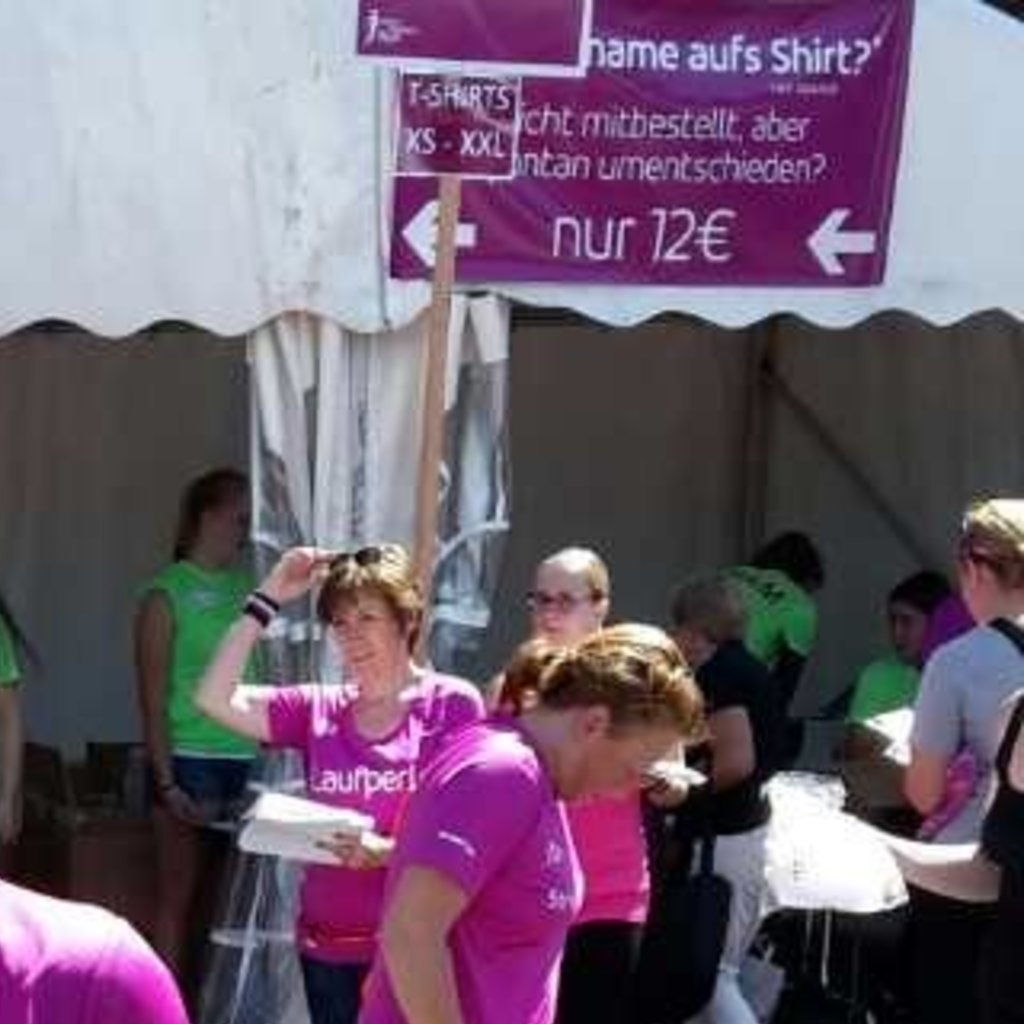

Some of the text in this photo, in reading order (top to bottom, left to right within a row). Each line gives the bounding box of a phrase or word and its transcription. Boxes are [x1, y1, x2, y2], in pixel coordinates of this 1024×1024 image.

[687, 35, 762, 73] aufs
[409, 81, 512, 110] T-SHIRTS
[520, 101, 809, 143] icht mitbestellt, aber
[404, 127, 437, 155] XS
[460, 129, 506, 158] XXL
[597, 147, 827, 183] umentschieden?
[553, 207, 737, 262] nur 12€
